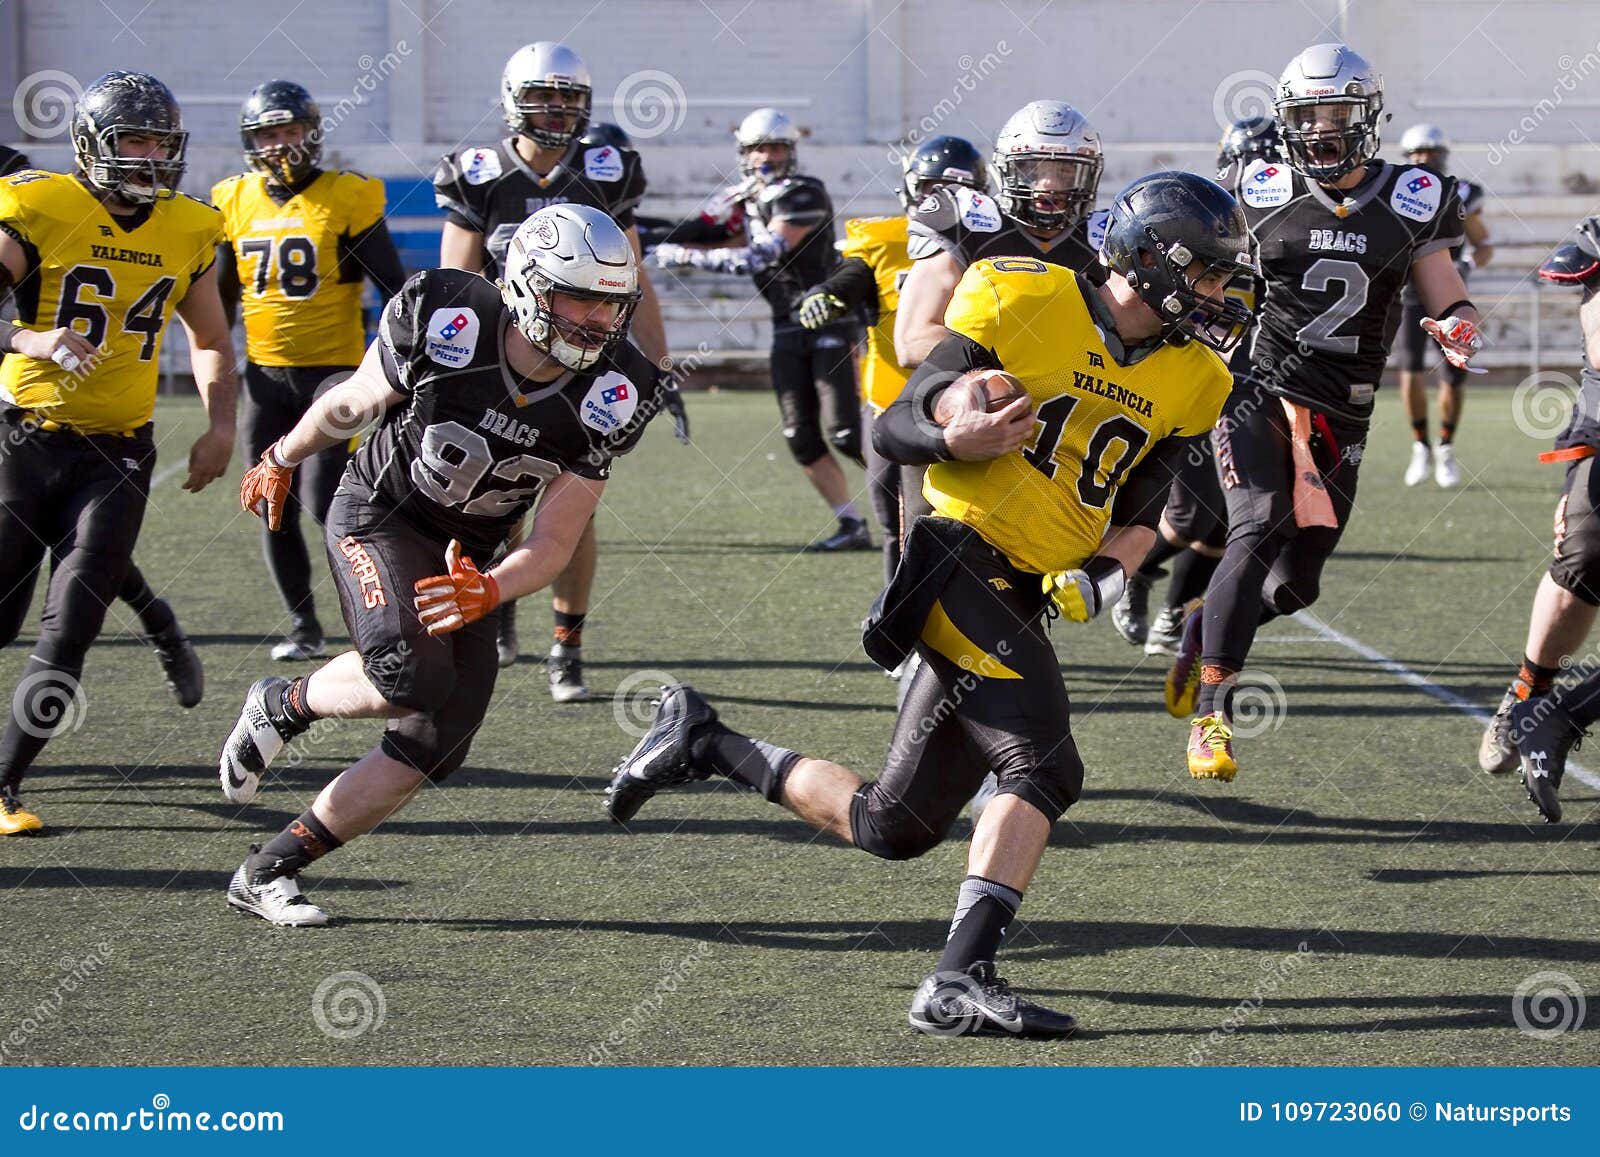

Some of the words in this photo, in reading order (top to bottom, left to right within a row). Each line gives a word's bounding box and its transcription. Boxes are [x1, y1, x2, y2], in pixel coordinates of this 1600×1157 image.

[1256, 194, 1280, 203] Pizza
[1396, 193, 1433, 213] Domino's
[1400, 202, 1424, 217] Pizza
[1308, 229, 1368, 254] DRACS
[90, 244, 163, 268] VALENCIA
[237, 235, 320, 300] 78
[55, 263, 177, 362] 64
[1296, 258, 1370, 354] 2
[429, 342, 470, 355] Domino's
[434, 350, 461, 363] Pizza
[1073, 371, 1154, 419] VALENCIA
[586, 400, 621, 427] Domino's
[589, 412, 610, 429] Pizza
[478, 408, 541, 449] DRACS
[1022, 393, 1151, 510] 10
[410, 420, 563, 518] 92
[337, 535, 388, 609] DRACS
